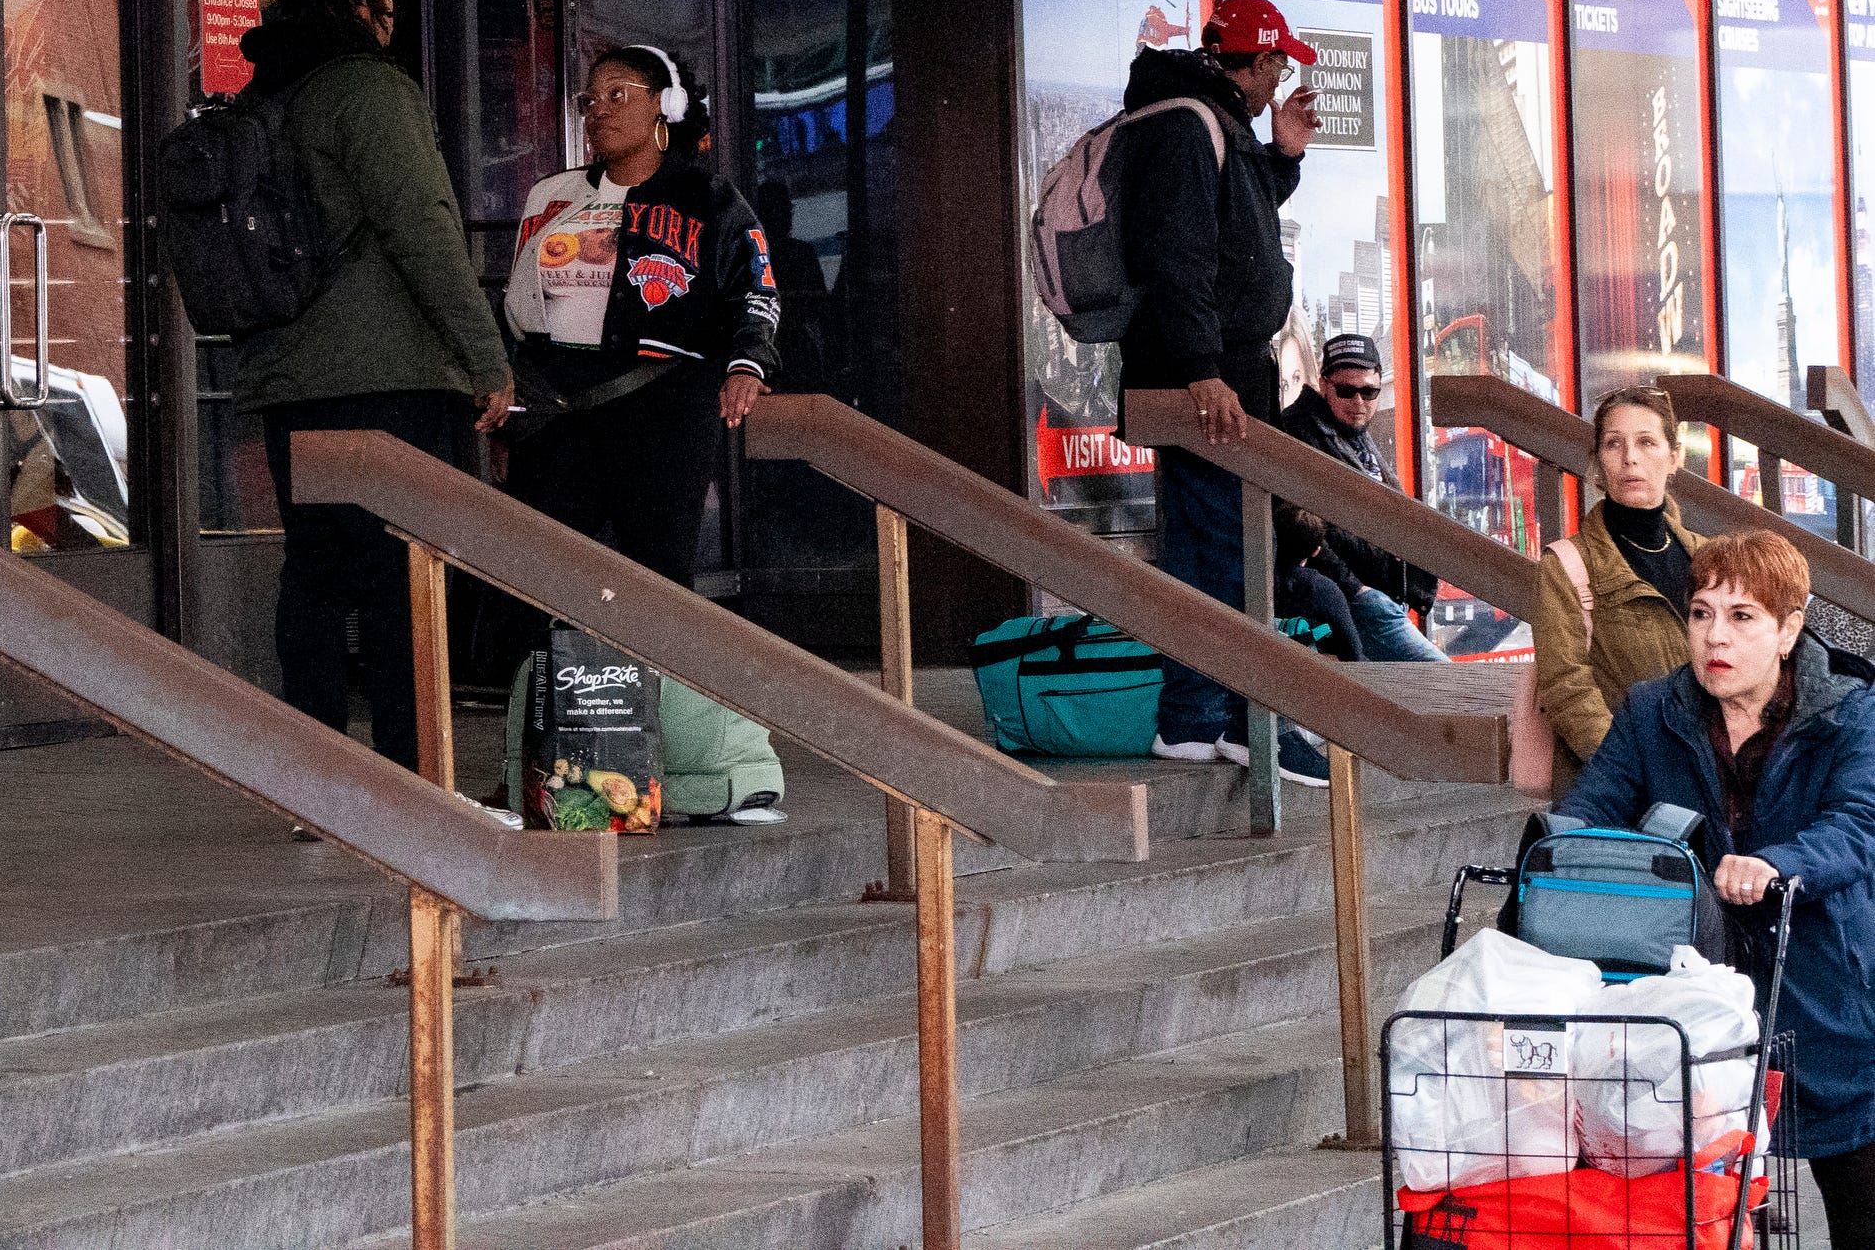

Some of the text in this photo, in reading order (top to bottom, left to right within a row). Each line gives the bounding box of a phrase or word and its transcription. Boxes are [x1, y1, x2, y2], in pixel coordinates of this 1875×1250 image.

[1574, 4, 1619, 34] TICKETS
[205, 33, 240, 46] Use 8th Ave
[1718, 25, 1760, 53] CRUISES
[1311, 70, 1362, 91] COMMON
[1314, 93, 1362, 114] PREMIUM
[626, 202, 704, 269] YORK
[575, 269, 584, 279] &
[631, 258, 688, 291] KNICKS
[1062, 433, 1106, 470] VISIT
[1109, 434, 1132, 467] US
[555, 663, 642, 694] ShopRite
[566, 707, 634, 716] make a difference!
[576, 697, 624, 707] Together, we
